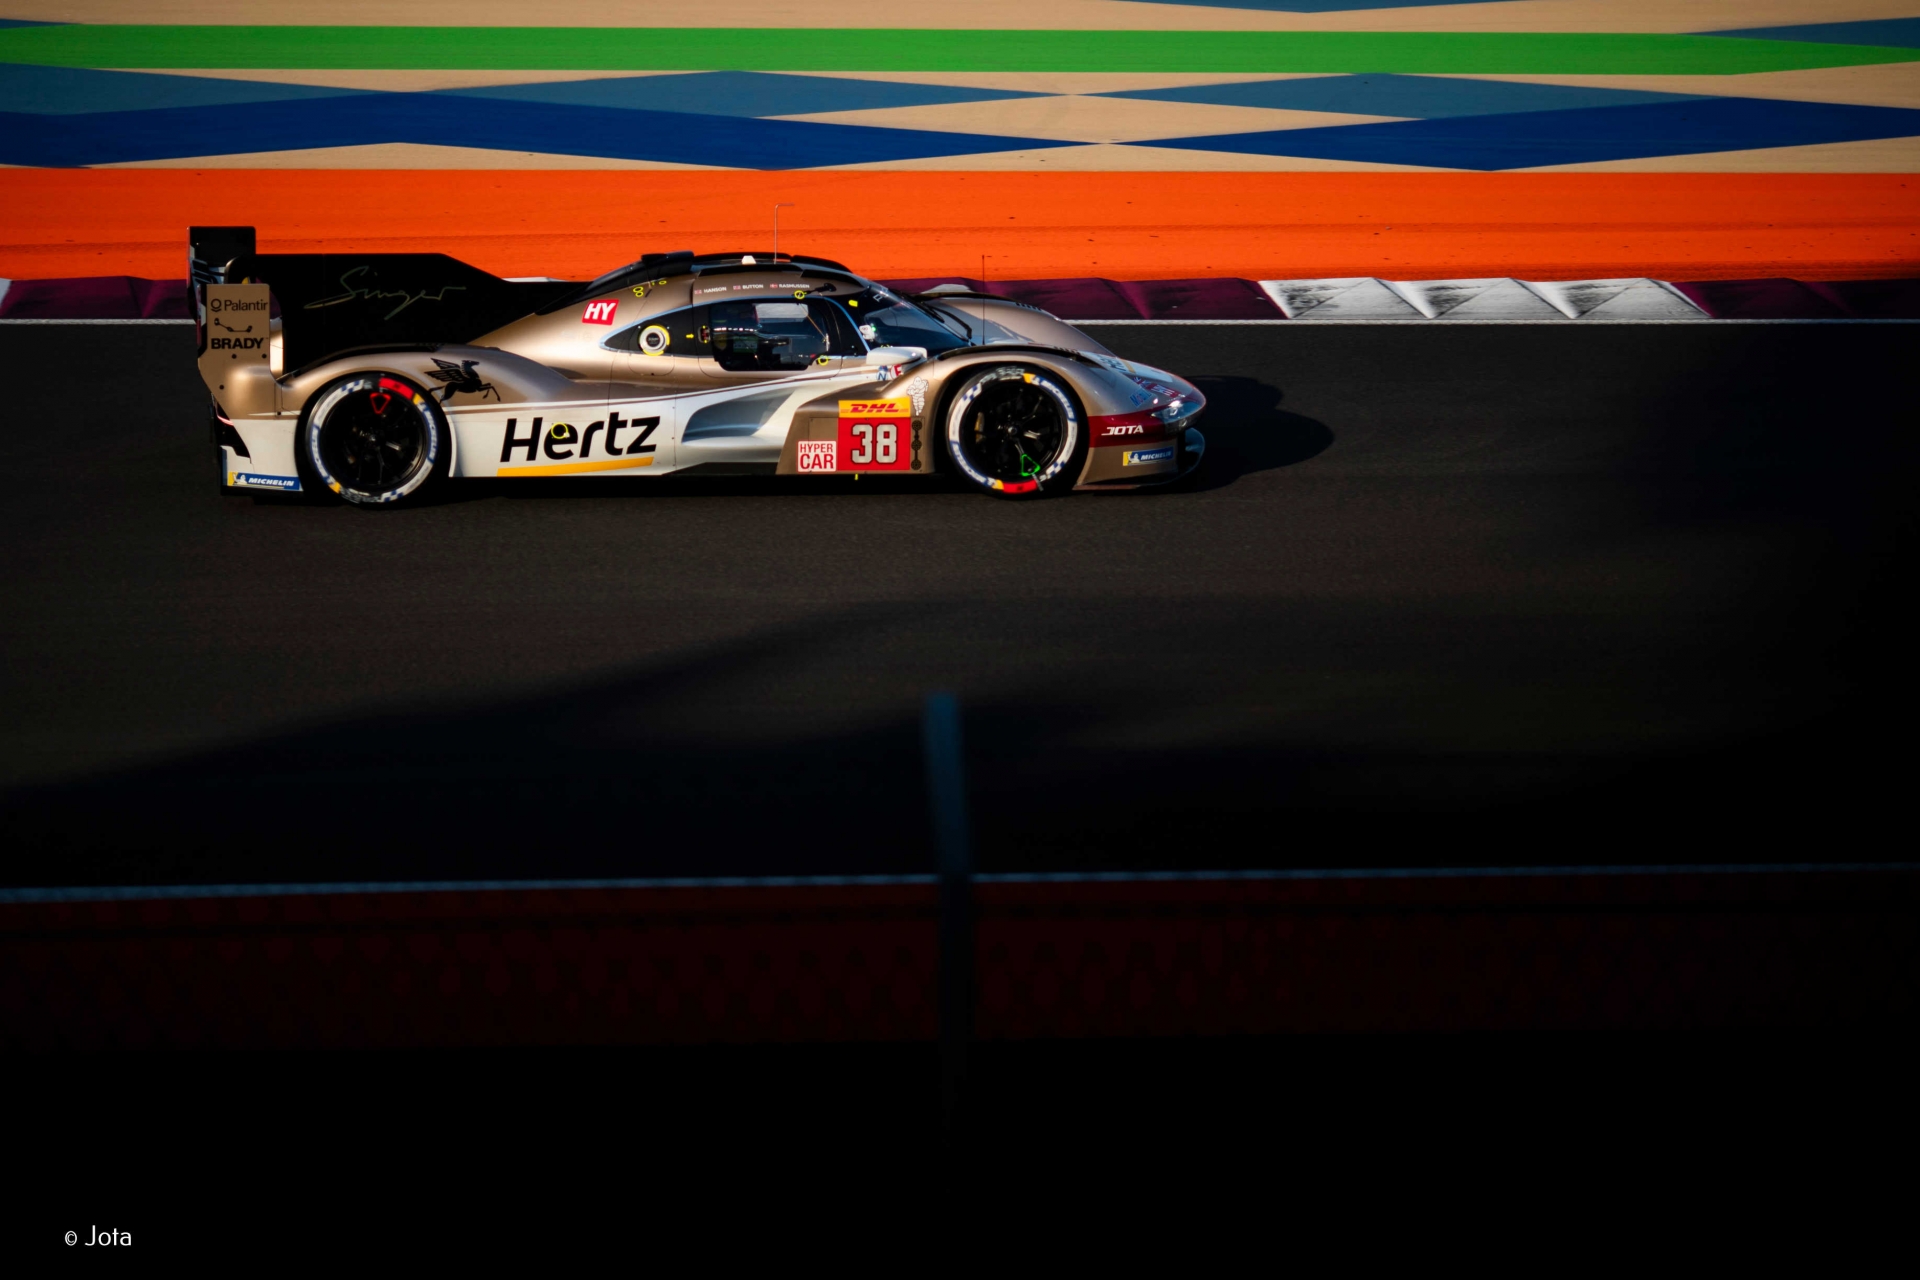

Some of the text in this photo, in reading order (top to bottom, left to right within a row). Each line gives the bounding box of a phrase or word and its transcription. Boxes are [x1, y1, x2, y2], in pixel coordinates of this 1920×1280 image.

[302, 265, 468, 321] Singer
[703, 286, 727, 294] HANSON
[224, 299, 268, 311] Palantir
[584, 302, 617, 321] HY
[211, 338, 263, 349] BRADY
[850, 403, 899, 413] DHL
[1101, 424, 1144, 436] JOTA
[500, 411, 661, 463] Hertz
[800, 443, 834, 453] HYPER
[851, 423, 898, 465] 38
[800, 453, 834, 470] CAR
[1140, 450, 1172, 461] MICHELIN
[248, 477, 295, 487] MICHELIN
